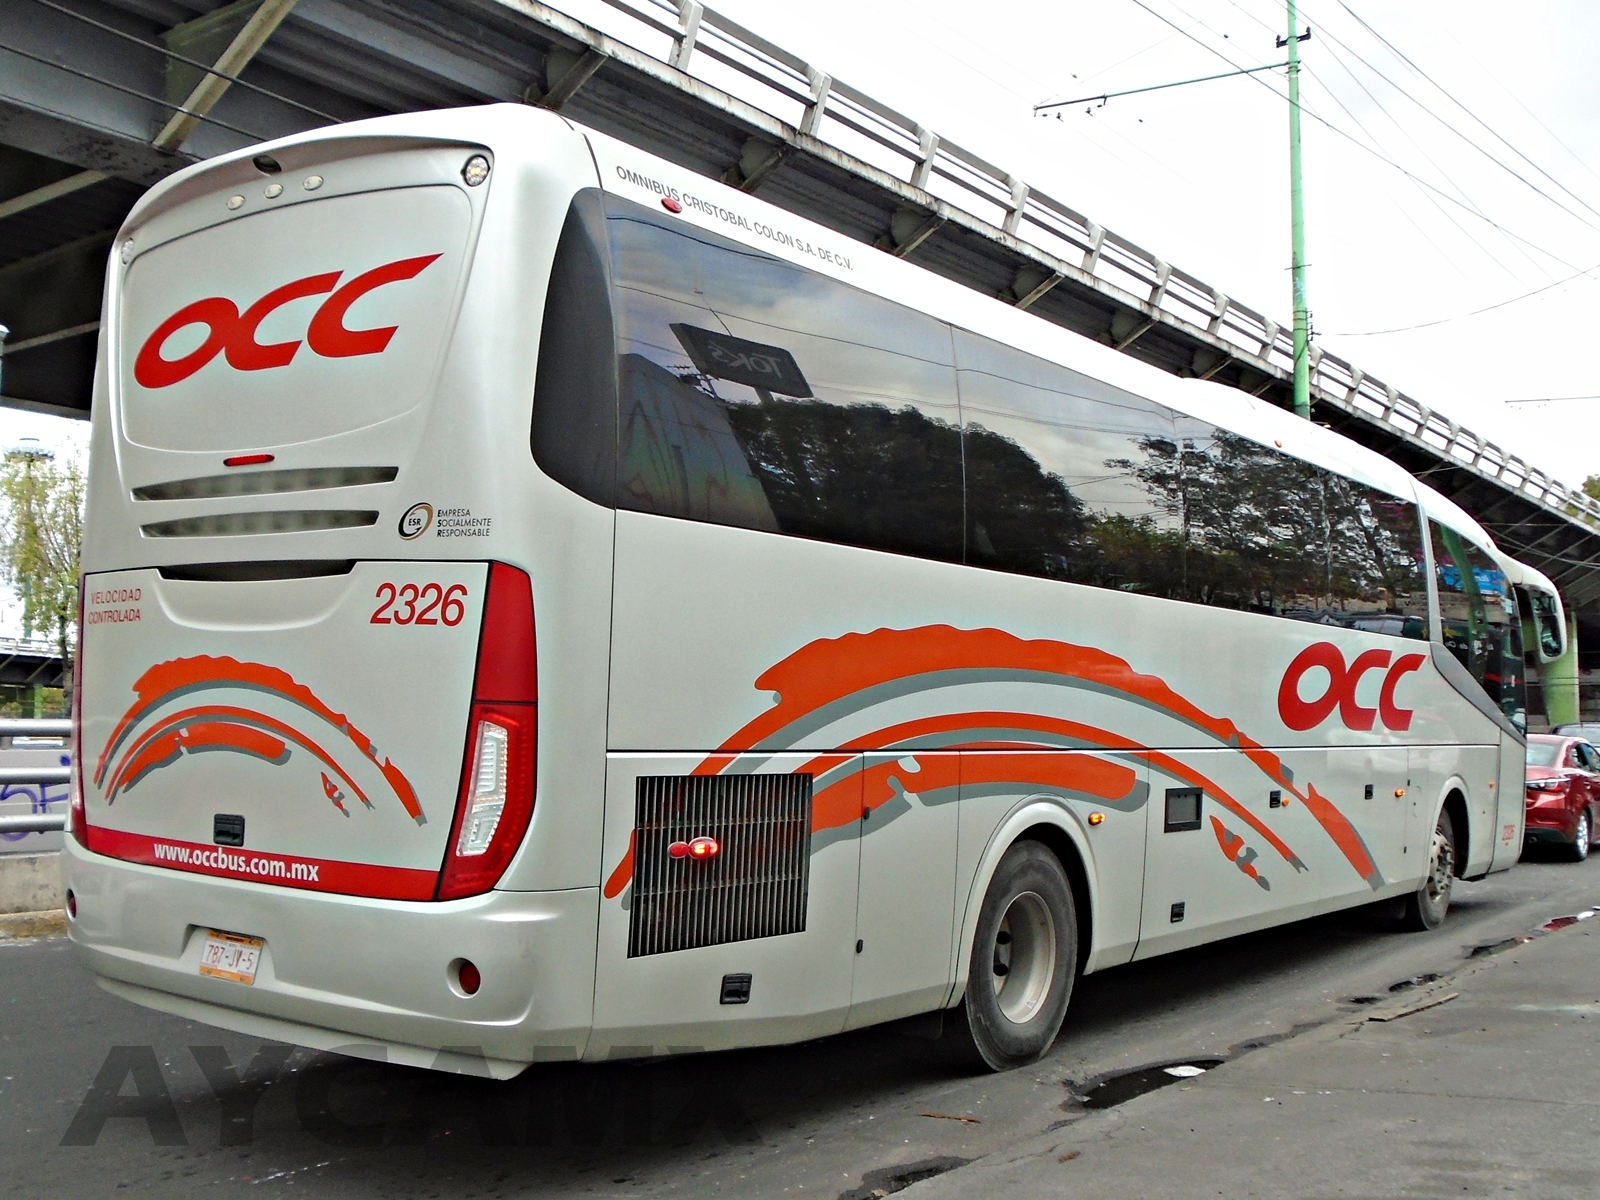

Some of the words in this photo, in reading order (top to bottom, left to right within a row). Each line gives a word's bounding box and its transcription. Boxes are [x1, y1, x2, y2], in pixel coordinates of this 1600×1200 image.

[615, 165, 680, 202] OMNIBUS
[682, 193, 752, 232] CRISTOBAL
[753, 221, 795, 248] COLON
[795, 238, 817, 257] S.A.
[817, 246, 834, 263] DE
[834, 253, 854, 271] C.V.
[133, 252, 445, 389] OCC
[437, 508, 471, 518] EMPRESA
[408, 518, 422, 527] ESR
[437, 517, 492, 528] SOCIALMENTE
[436, 527, 491, 538] RESPONSABLE
[90, 588, 142, 605] VELOCIDAD
[370, 582, 468, 627] 2326
[88, 608, 141, 625] CONTROLADA
[1277, 641, 1427, 732] OCC
[153, 842, 320, 882] www.occbus.com.mx
